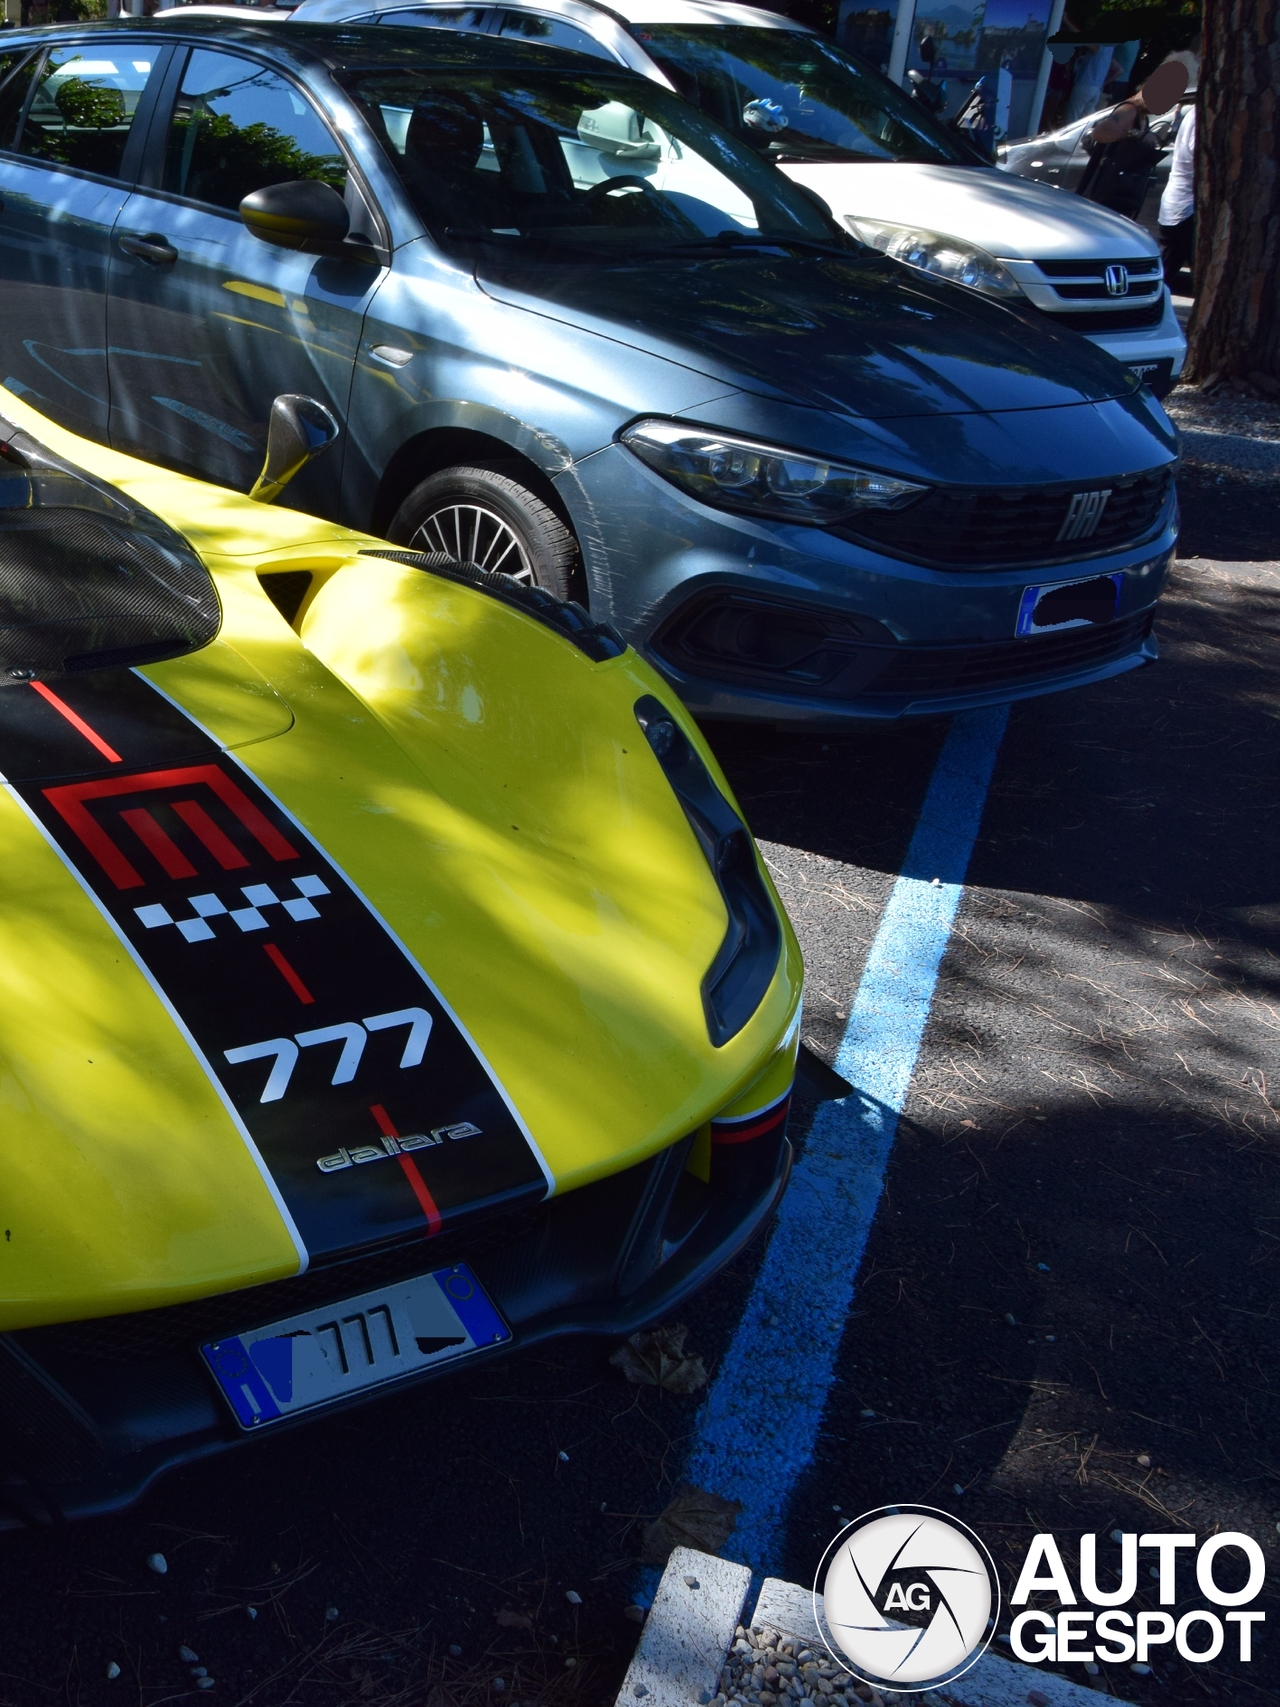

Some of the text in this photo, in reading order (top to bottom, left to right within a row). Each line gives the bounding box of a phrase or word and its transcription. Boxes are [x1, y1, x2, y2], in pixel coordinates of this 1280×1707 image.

[1055, 489, 1112, 542] FIAT
[223, 1007, 433, 1104] 777
[316, 1121, 483, 1173] dallara
[316, 1303, 400, 1374] 777
